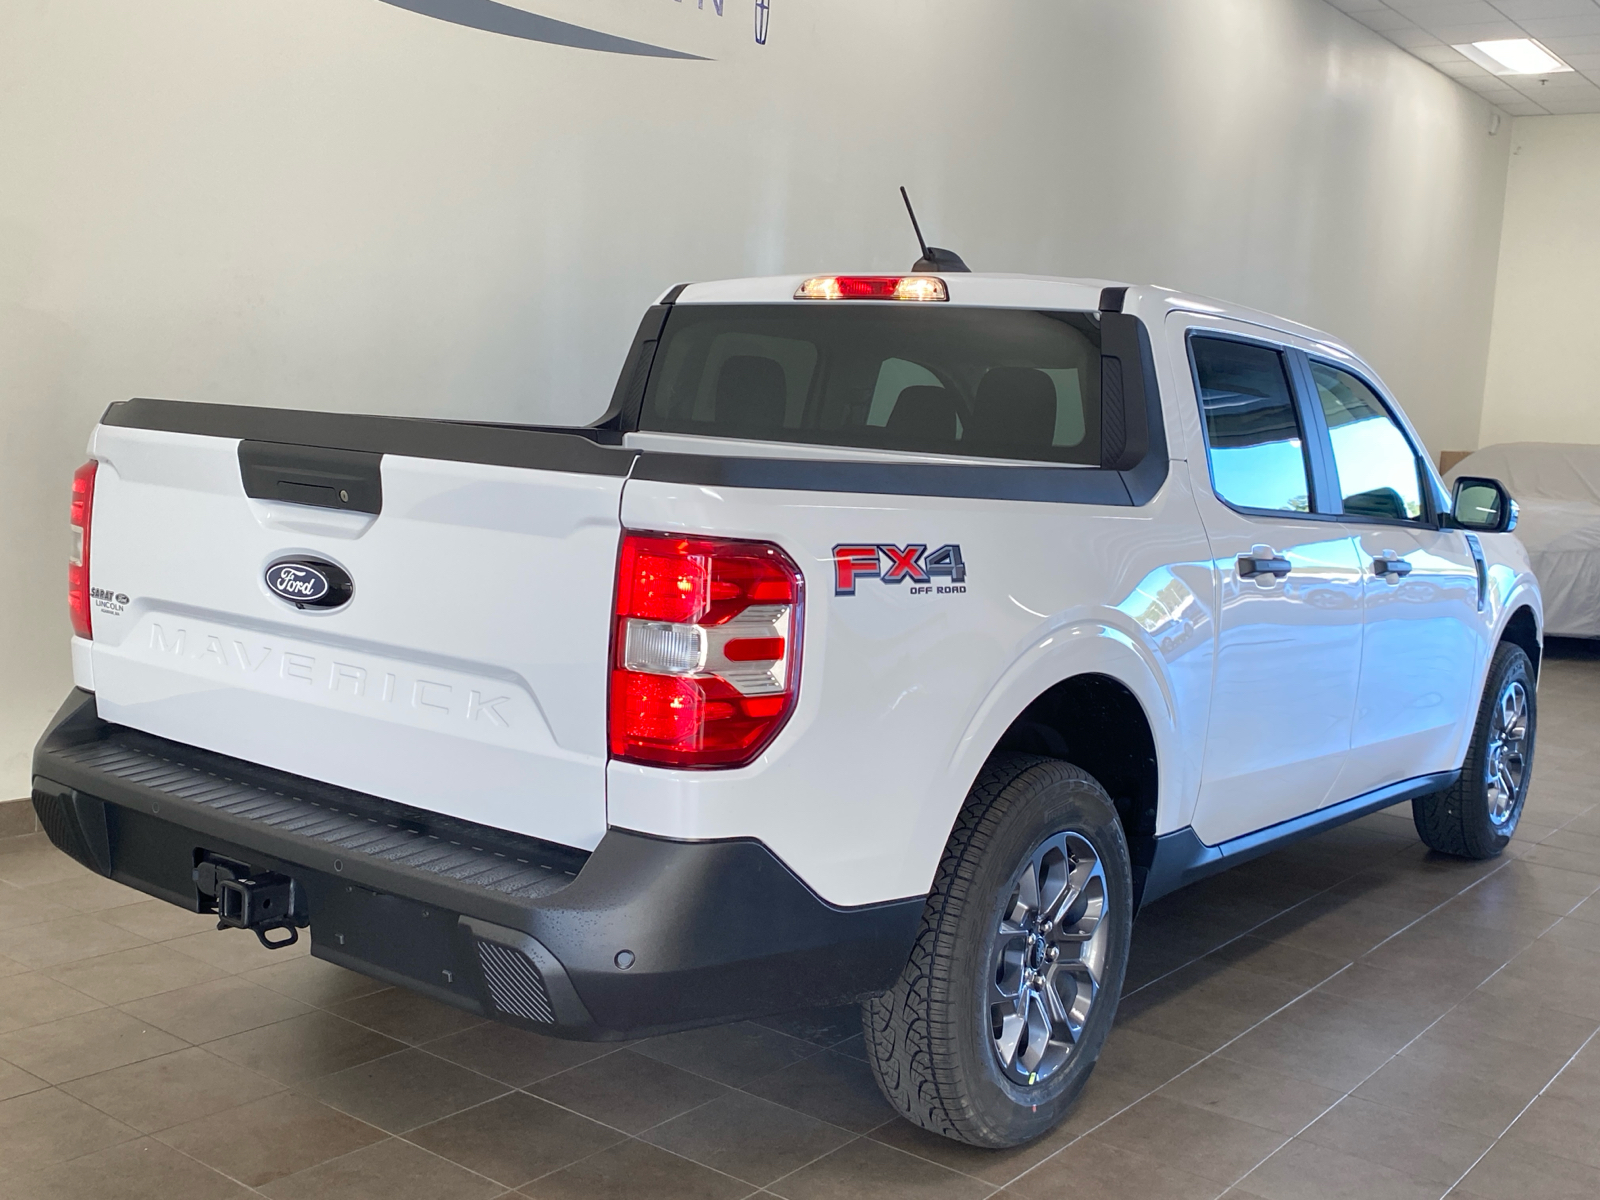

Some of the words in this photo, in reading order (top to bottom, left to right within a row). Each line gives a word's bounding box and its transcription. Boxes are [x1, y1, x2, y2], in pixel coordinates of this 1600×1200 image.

[831, 543, 967, 597] FX4
[277, 567, 315, 595] Ford
[910, 586, 933, 595] OFF
[936, 585, 967, 594] ROAD
[91, 587, 114, 602] SARAT
[96, 600, 124, 611] LINCOLN
[149, 623, 511, 727] MAVERICK
